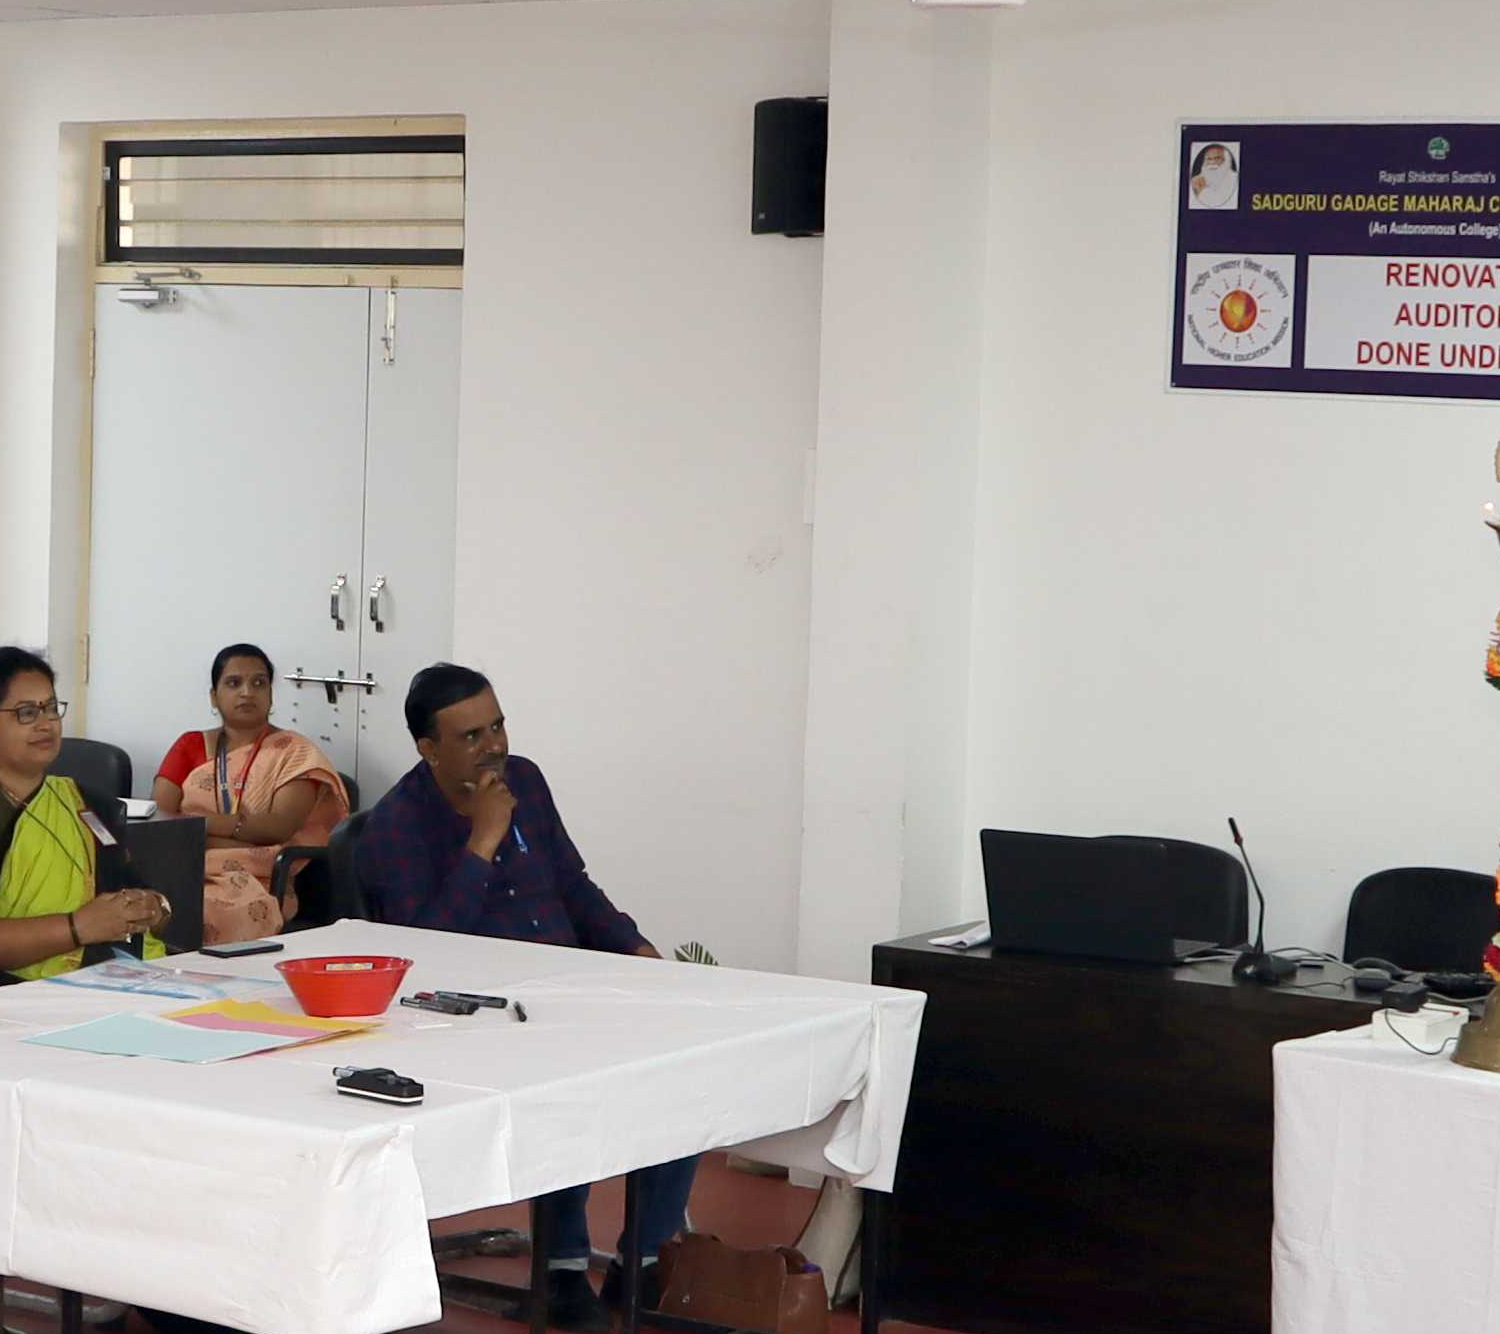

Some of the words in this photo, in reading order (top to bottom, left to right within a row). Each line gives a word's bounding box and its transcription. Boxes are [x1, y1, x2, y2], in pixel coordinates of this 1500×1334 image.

[1251, 194, 1327, 212] SADGURU
[1331, 195, 1398, 212] GADAGE
[1403, 195, 1483, 213] MAHARAJ
[1368, 221, 1387, 237] (An
[1388, 222, 1456, 236] Autonomous
[1356, 340, 1431, 367] DONE
